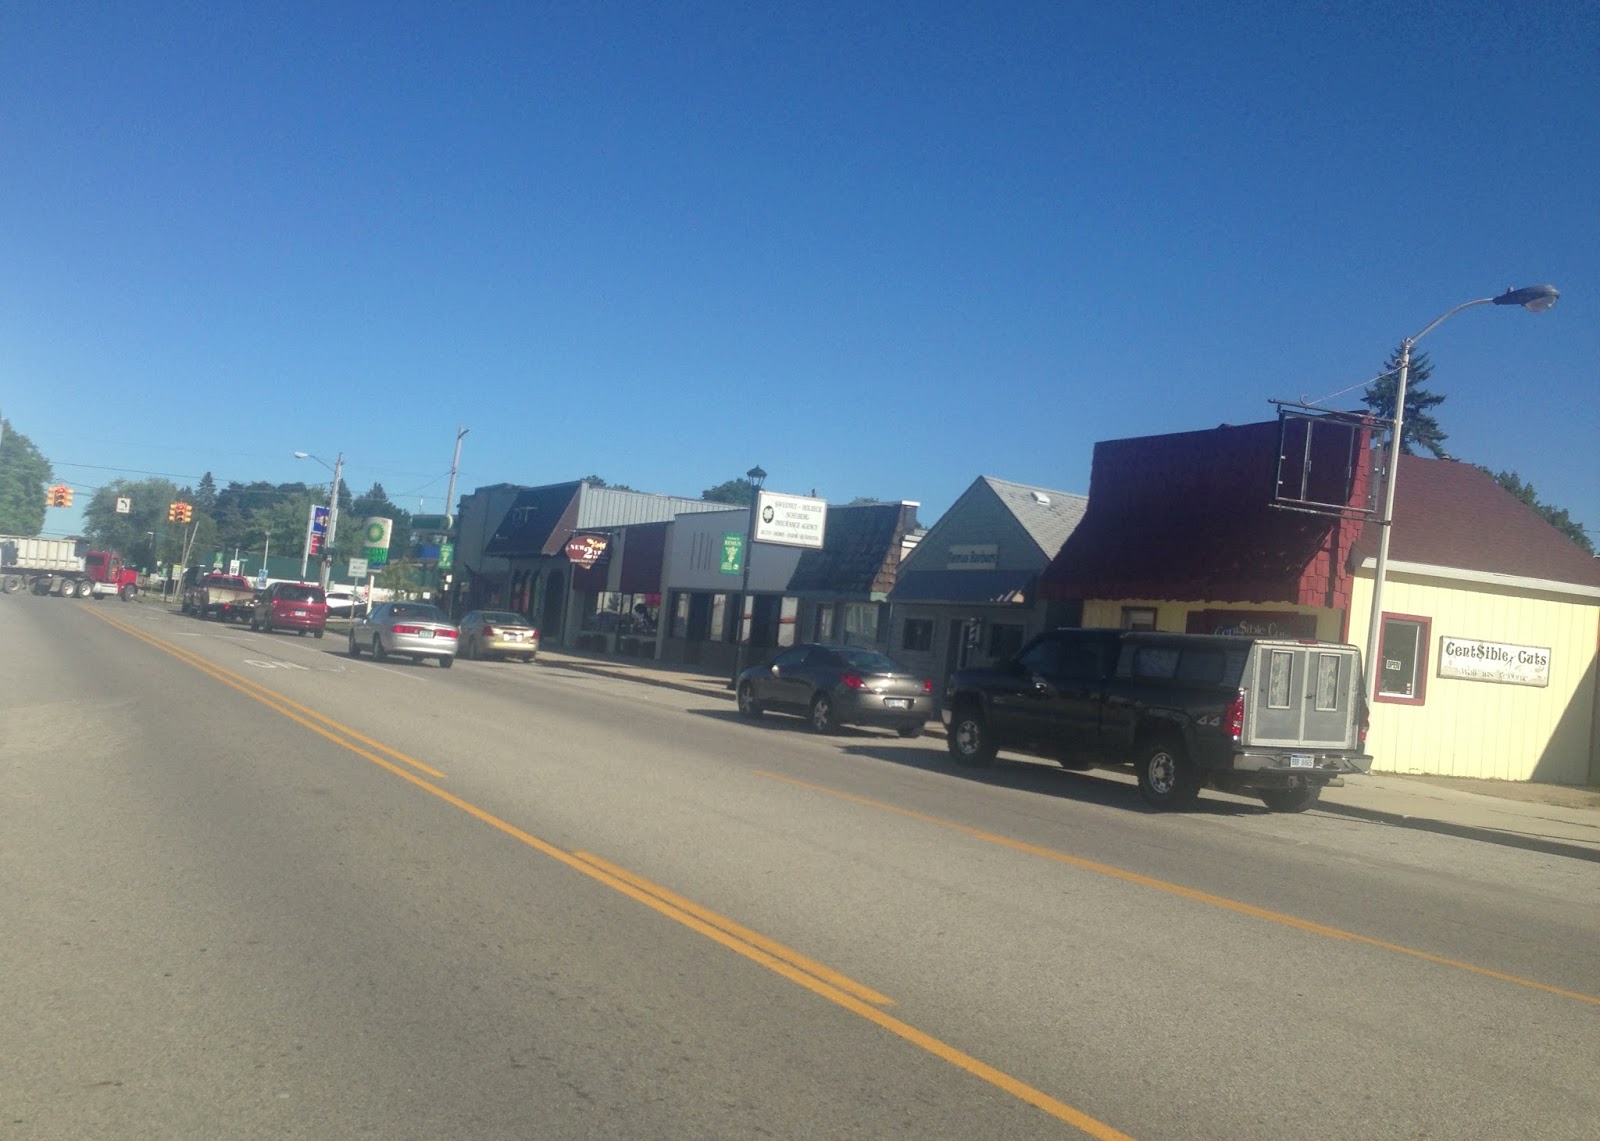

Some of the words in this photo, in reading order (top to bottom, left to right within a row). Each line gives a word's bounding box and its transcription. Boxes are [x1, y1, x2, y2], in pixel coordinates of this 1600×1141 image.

[774, 519, 800, 529] INSURANCE
[801, 523, 819, 531] AGENCY
[1518, 650, 1547, 666] Cuts
[1387, 660, 1401, 669] OPEN
